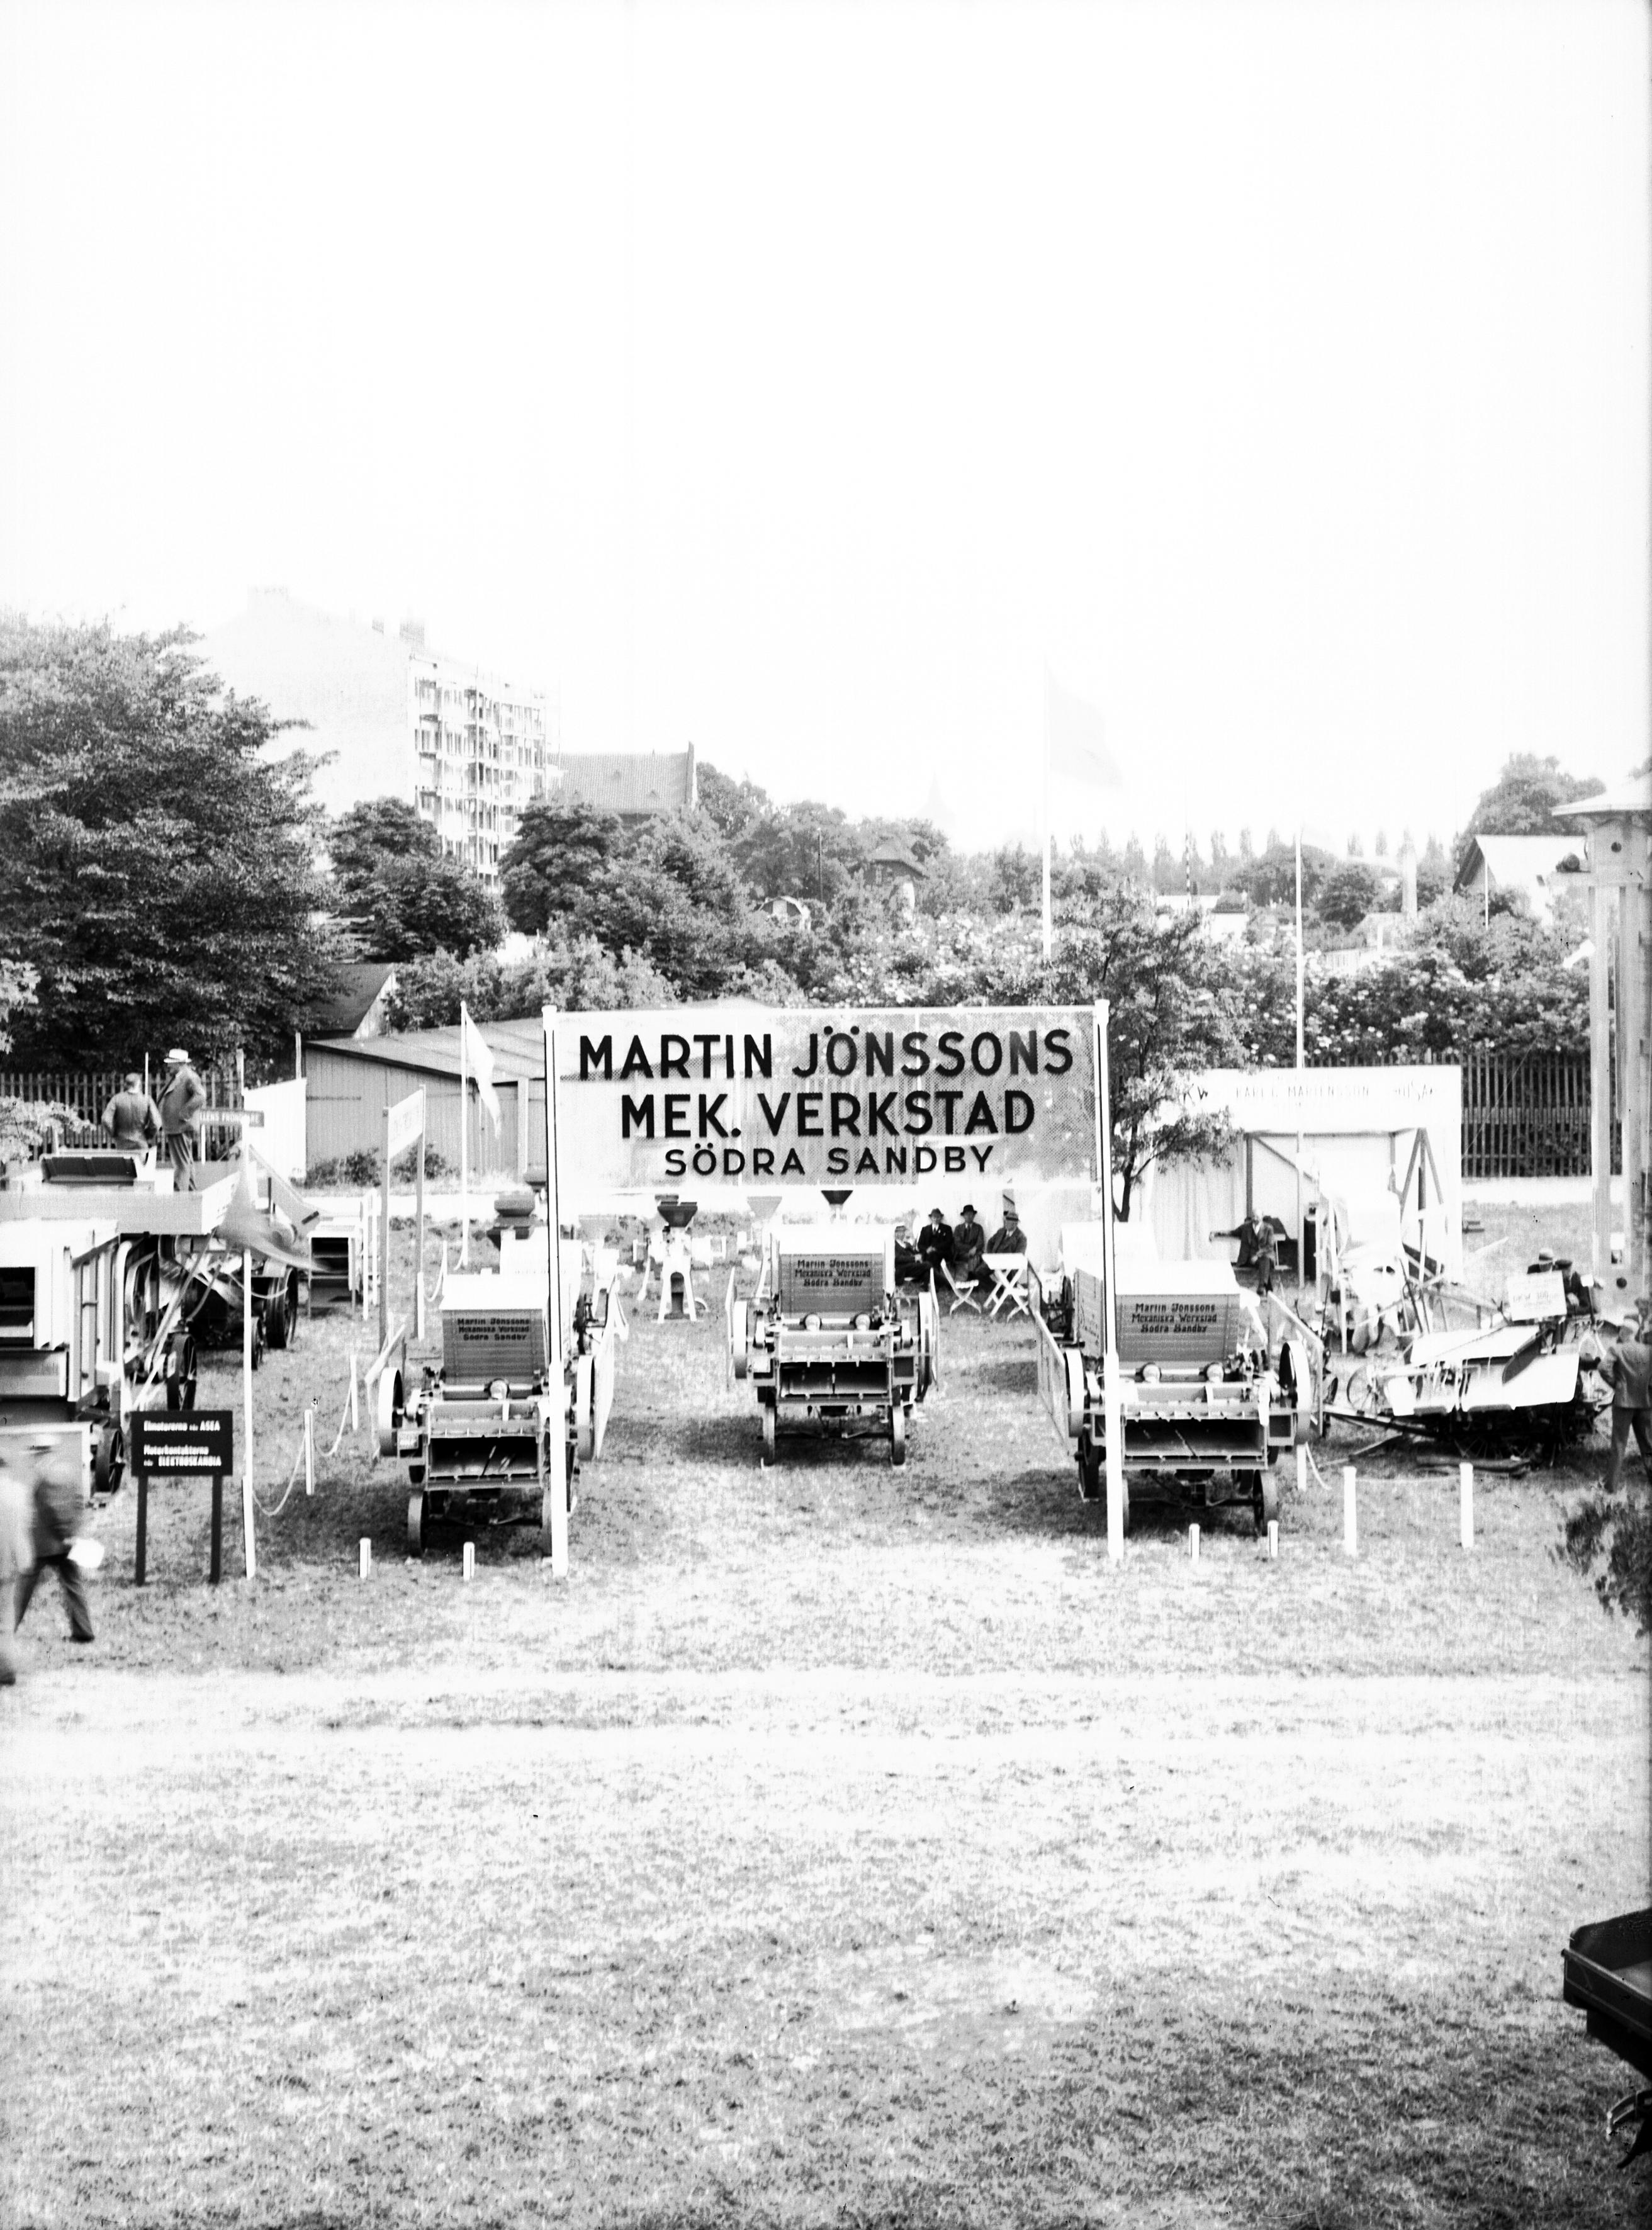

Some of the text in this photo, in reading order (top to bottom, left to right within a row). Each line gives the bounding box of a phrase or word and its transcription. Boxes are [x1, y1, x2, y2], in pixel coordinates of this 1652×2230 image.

[579, 1025, 1074, 1081] MARTIN JÖNSSONS
[621, 1090, 1035, 1139] MEK. VERKSTAD
[665, 1142, 993, 1176] SÖDRA SANDBY
[797, 1259, 825, 1268] Martin
[1135, 1303, 1167, 1313] Martin
[199, 1420, 221, 1432] ASEA
